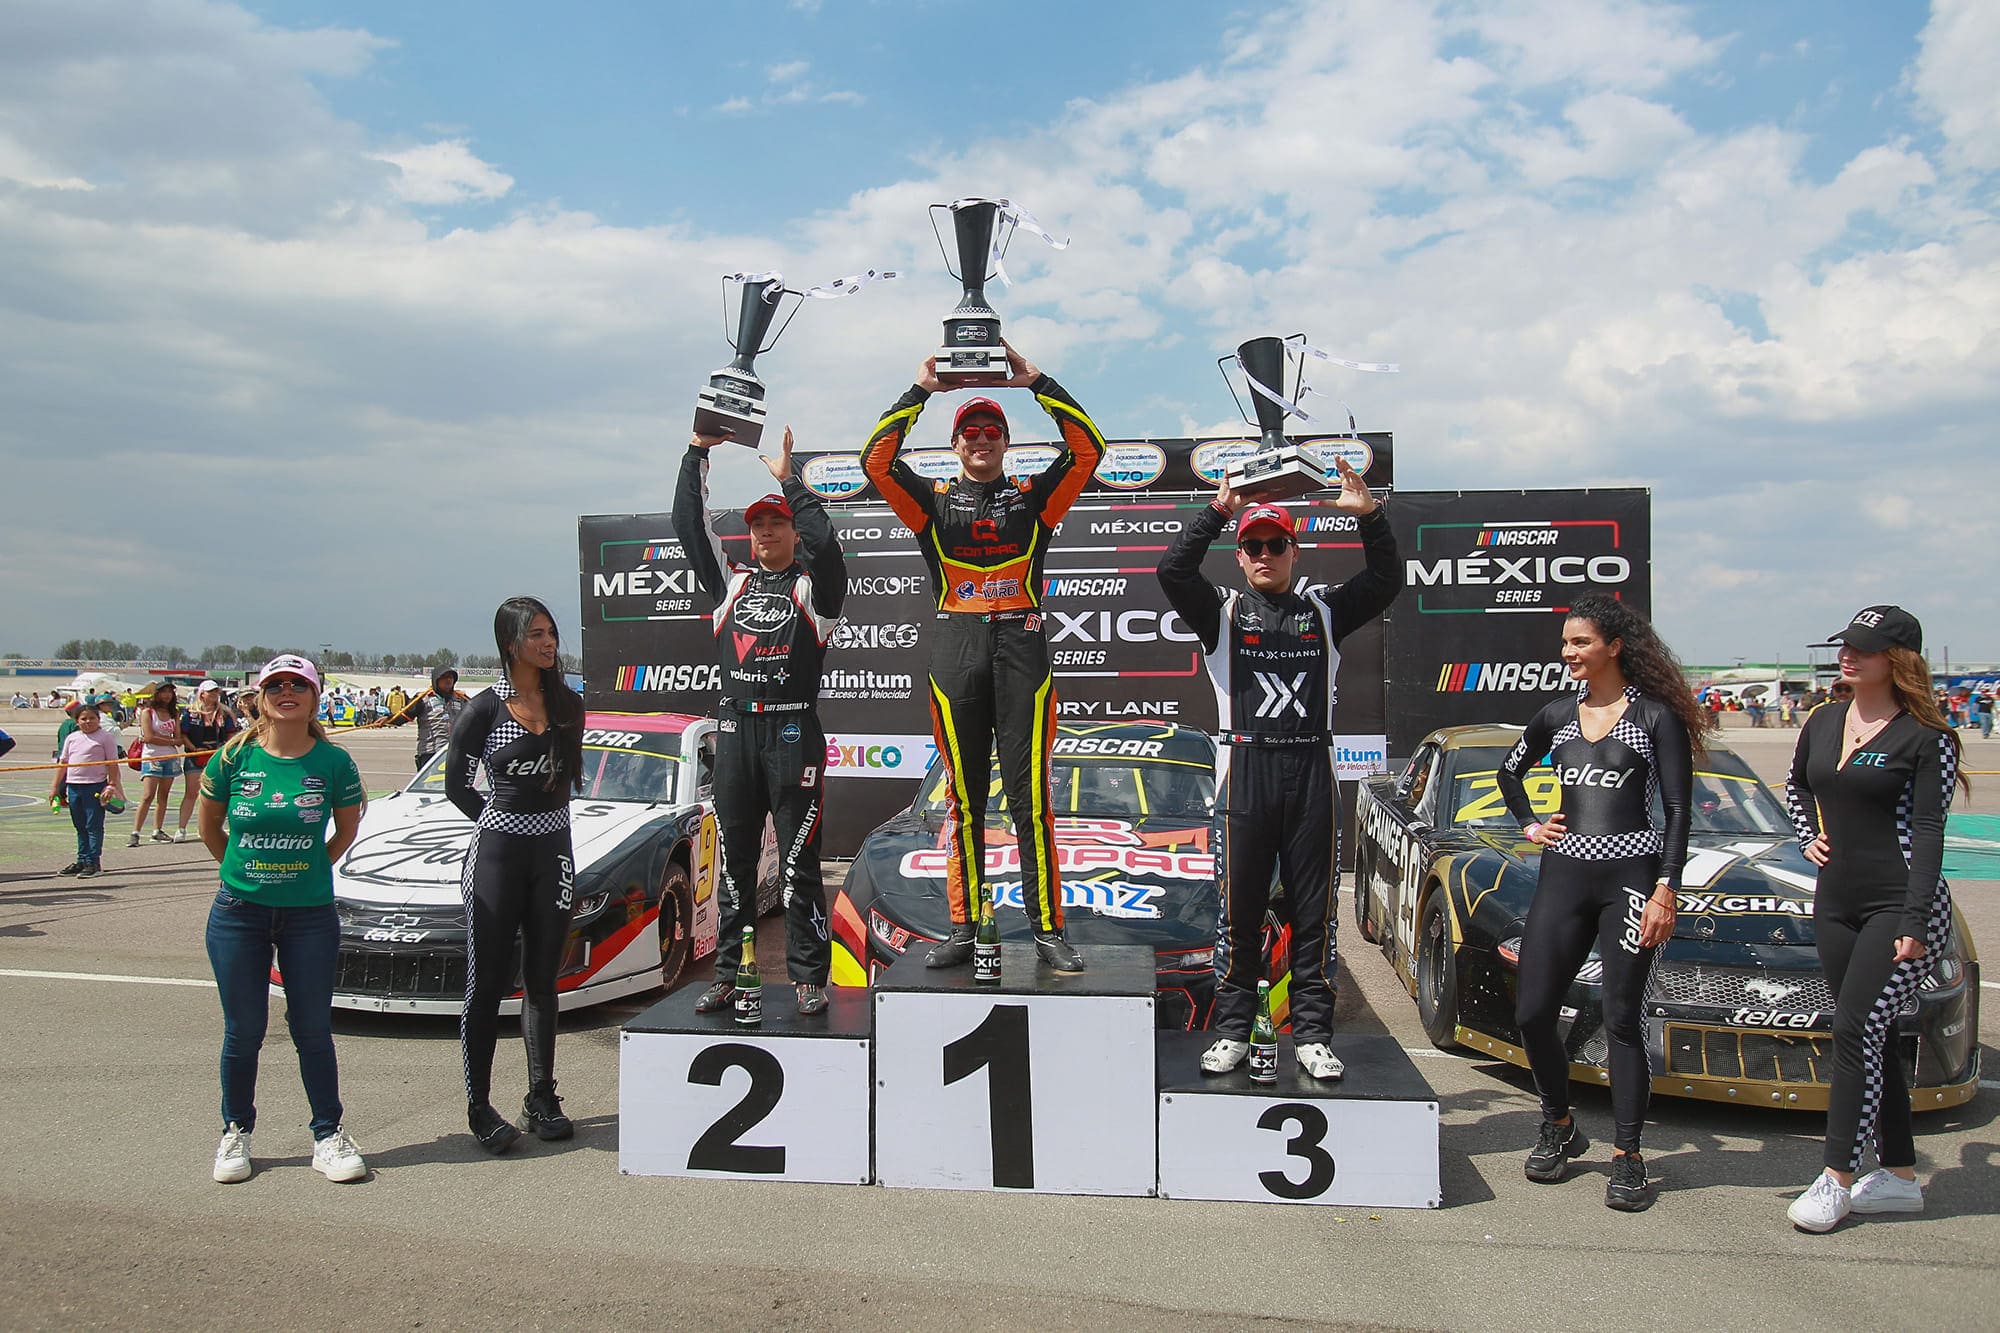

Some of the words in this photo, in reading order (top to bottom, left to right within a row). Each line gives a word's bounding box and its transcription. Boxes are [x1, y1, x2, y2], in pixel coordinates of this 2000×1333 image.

[821, 481, 852, 493] 170
[1110, 471, 1144, 482] 170
[1090, 518, 1183, 534] MÉXICO
[1496, 530, 1559, 546] NASCAR
[1405, 550, 1631, 586] MÉXICO
[593, 565, 707, 597] MÉXI
[1055, 578, 1128, 597] NASCAR
[655, 599, 692, 612] SERIES
[1495, 590, 1542, 603] SERIES
[742, 598, 790, 623] Gates
[1854, 610, 1884, 624] ZTE
[1024, 613, 1041, 633] 67
[1046, 610, 1200, 643] XICO
[755, 644, 791, 656] VAZLO
[1053, 650, 1107, 665] SERIES
[642, 664, 723, 691] NASCA
[730, 667, 768, 683] volaris
[820, 669, 912, 689] nfinitum
[830, 689, 857, 699] Exceso
[858, 689, 869, 699] de
[870, 689, 912, 699] Velocidad
[1105, 701, 1179, 715] LANE
[581, 729, 643, 749] CAR
[1052, 737, 1164, 758] ASCAR
[1504, 735, 1528, 773] telcel
[1853, 751, 1889, 768] ZTE
[464, 753, 479, 789] telcel
[801, 766, 817, 787] 9
[1555, 763, 1635, 789] telcel
[1454, 775, 1562, 823] 29
[694, 811, 718, 907] 9
[555, 854, 575, 911] telcel
[1618, 886, 1648, 954] telcel
[363, 928, 431, 944] telcel
[888, 926, 910, 952] 67
[1732, 1006, 1820, 1029] telcel
[943, 1004, 1035, 1189] 1
[686, 1042, 787, 1175] 2
[1255, 1102, 1337, 1200] 3
